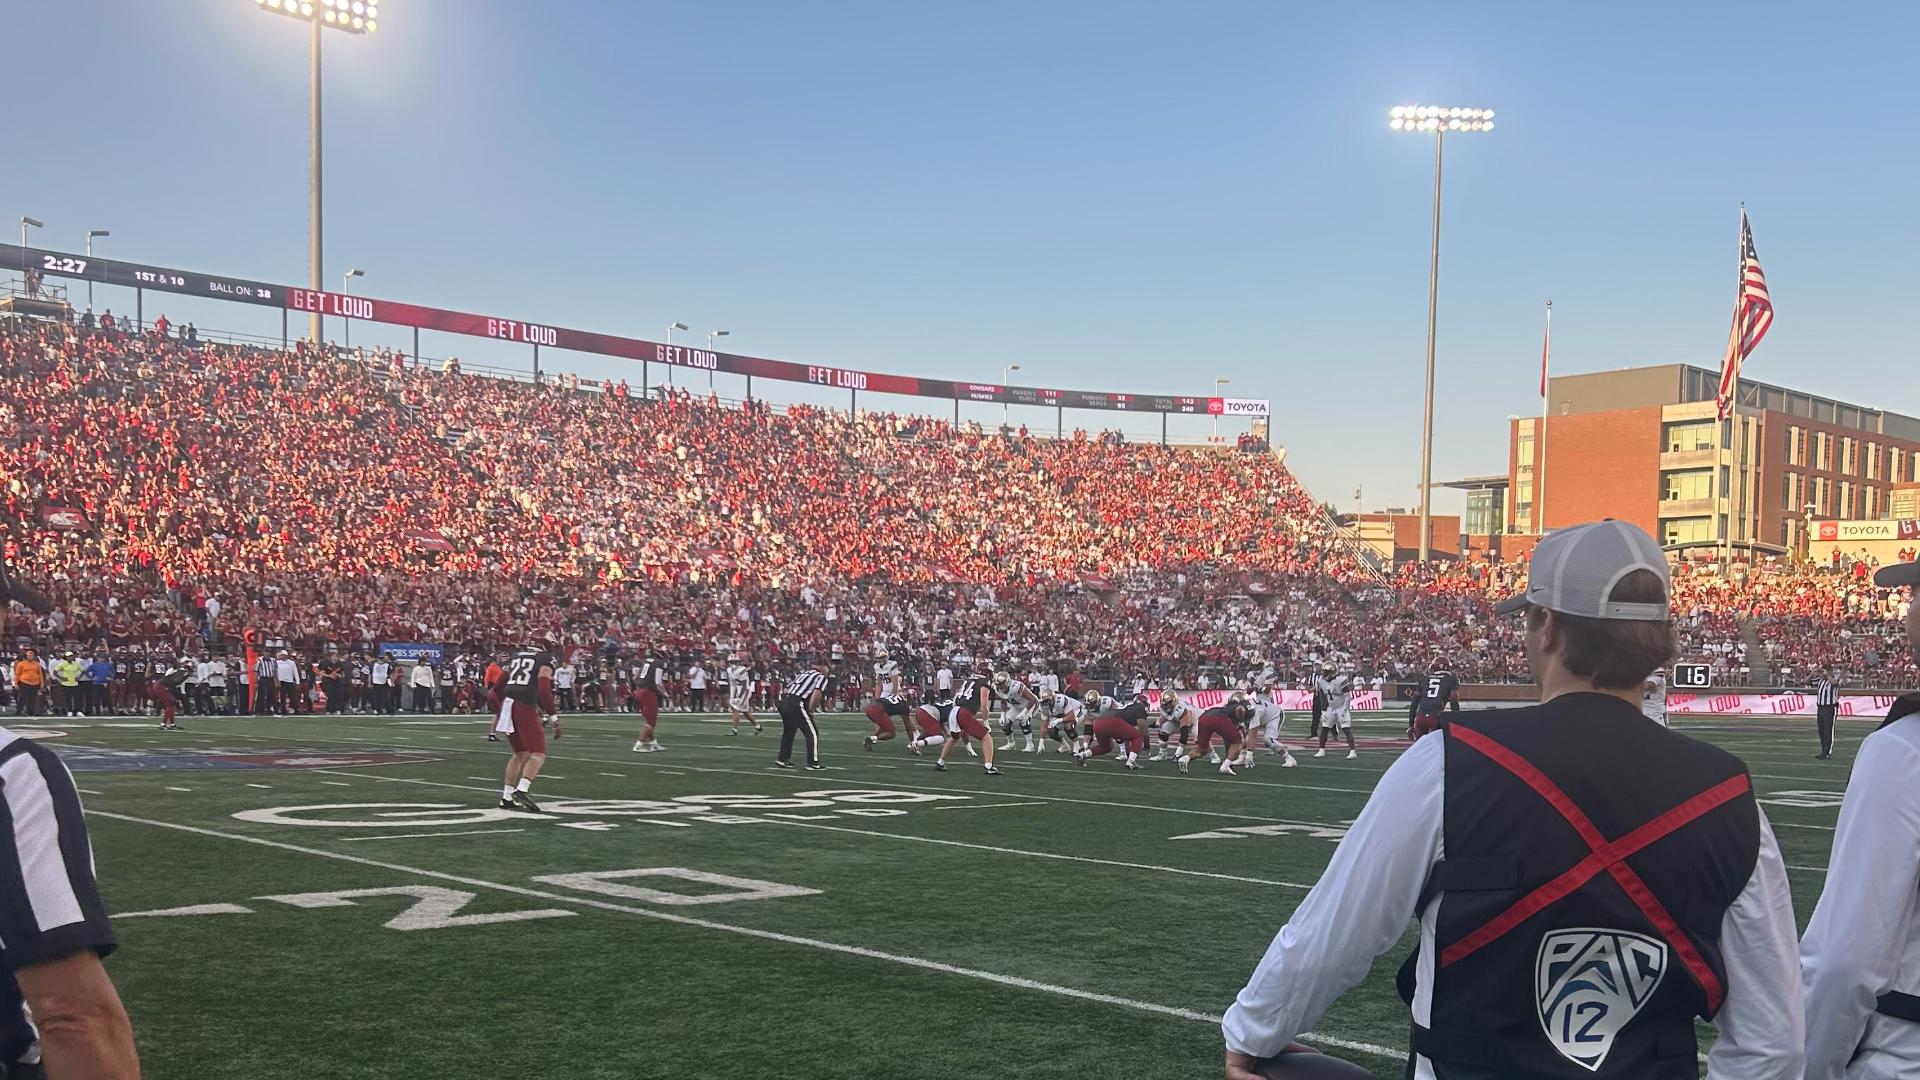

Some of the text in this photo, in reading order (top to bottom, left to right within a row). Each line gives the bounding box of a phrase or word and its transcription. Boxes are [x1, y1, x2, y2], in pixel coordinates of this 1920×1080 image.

[43, 255, 87, 274] 2:27
[134, 271, 185, 286] 1ST & 10
[209, 281, 272, 299] BALL ON: 38
[293, 289, 373, 319] GET LOUD
[487, 318, 557, 346] GET LOUD
[656, 344, 718, 370] GET LOUD
[808, 366, 867, 389] GET LOUD
[969, 385, 995, 393] COUGARS
[1227, 402, 1266, 412] TOYOTA
[1842, 526, 1890, 535] TOYOTA
[391, 648, 407, 657] CBS
[507, 657, 536, 685] 23
[1687, 666, 1705, 685] 16
[1427, 678, 1440, 698] 5
[1709, 694, 1741, 713] LOUD
[249, 867, 823, 932] 20
[1540, 933, 1661, 1013] PAC
[1562, 1001, 1609, 1043] 12
